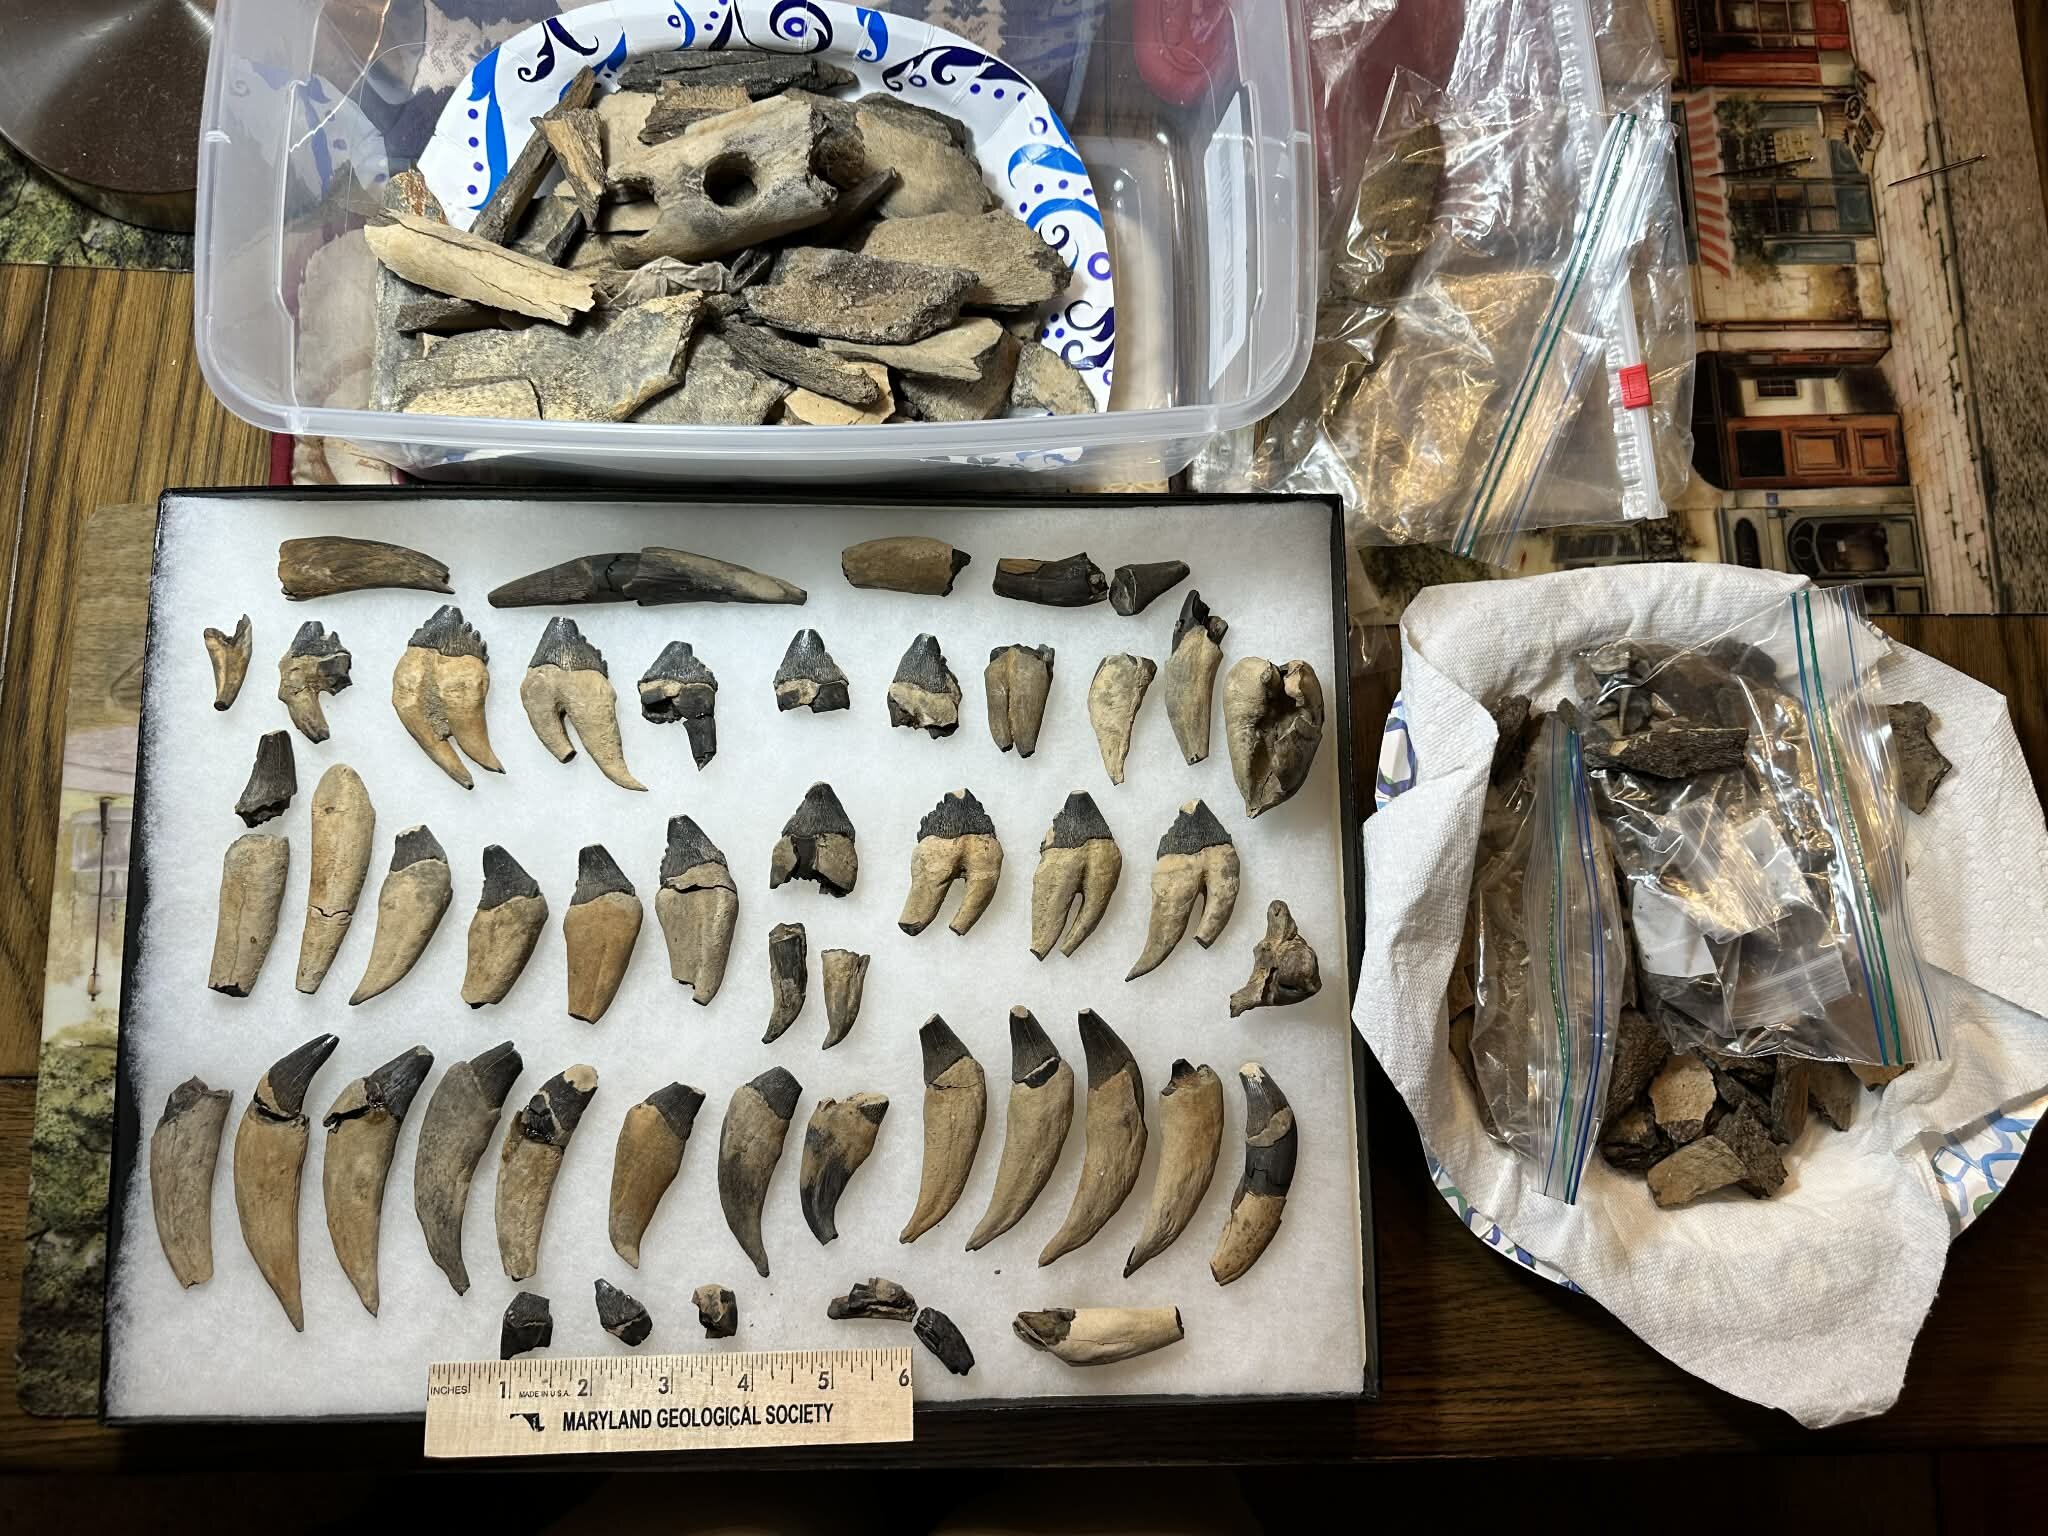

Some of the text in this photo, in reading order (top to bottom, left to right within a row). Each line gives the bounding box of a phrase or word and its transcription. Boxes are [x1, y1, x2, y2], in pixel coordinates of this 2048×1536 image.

[430, 1385, 468, 1396] INCHES
[499, 1368, 910, 1399] 1 2 3 4 5 6
[518, 1389, 571, 1398] MADE IN US.A.
[562, 1403, 834, 1432] MARYLAND GEOLOGICAL SOCIETY
